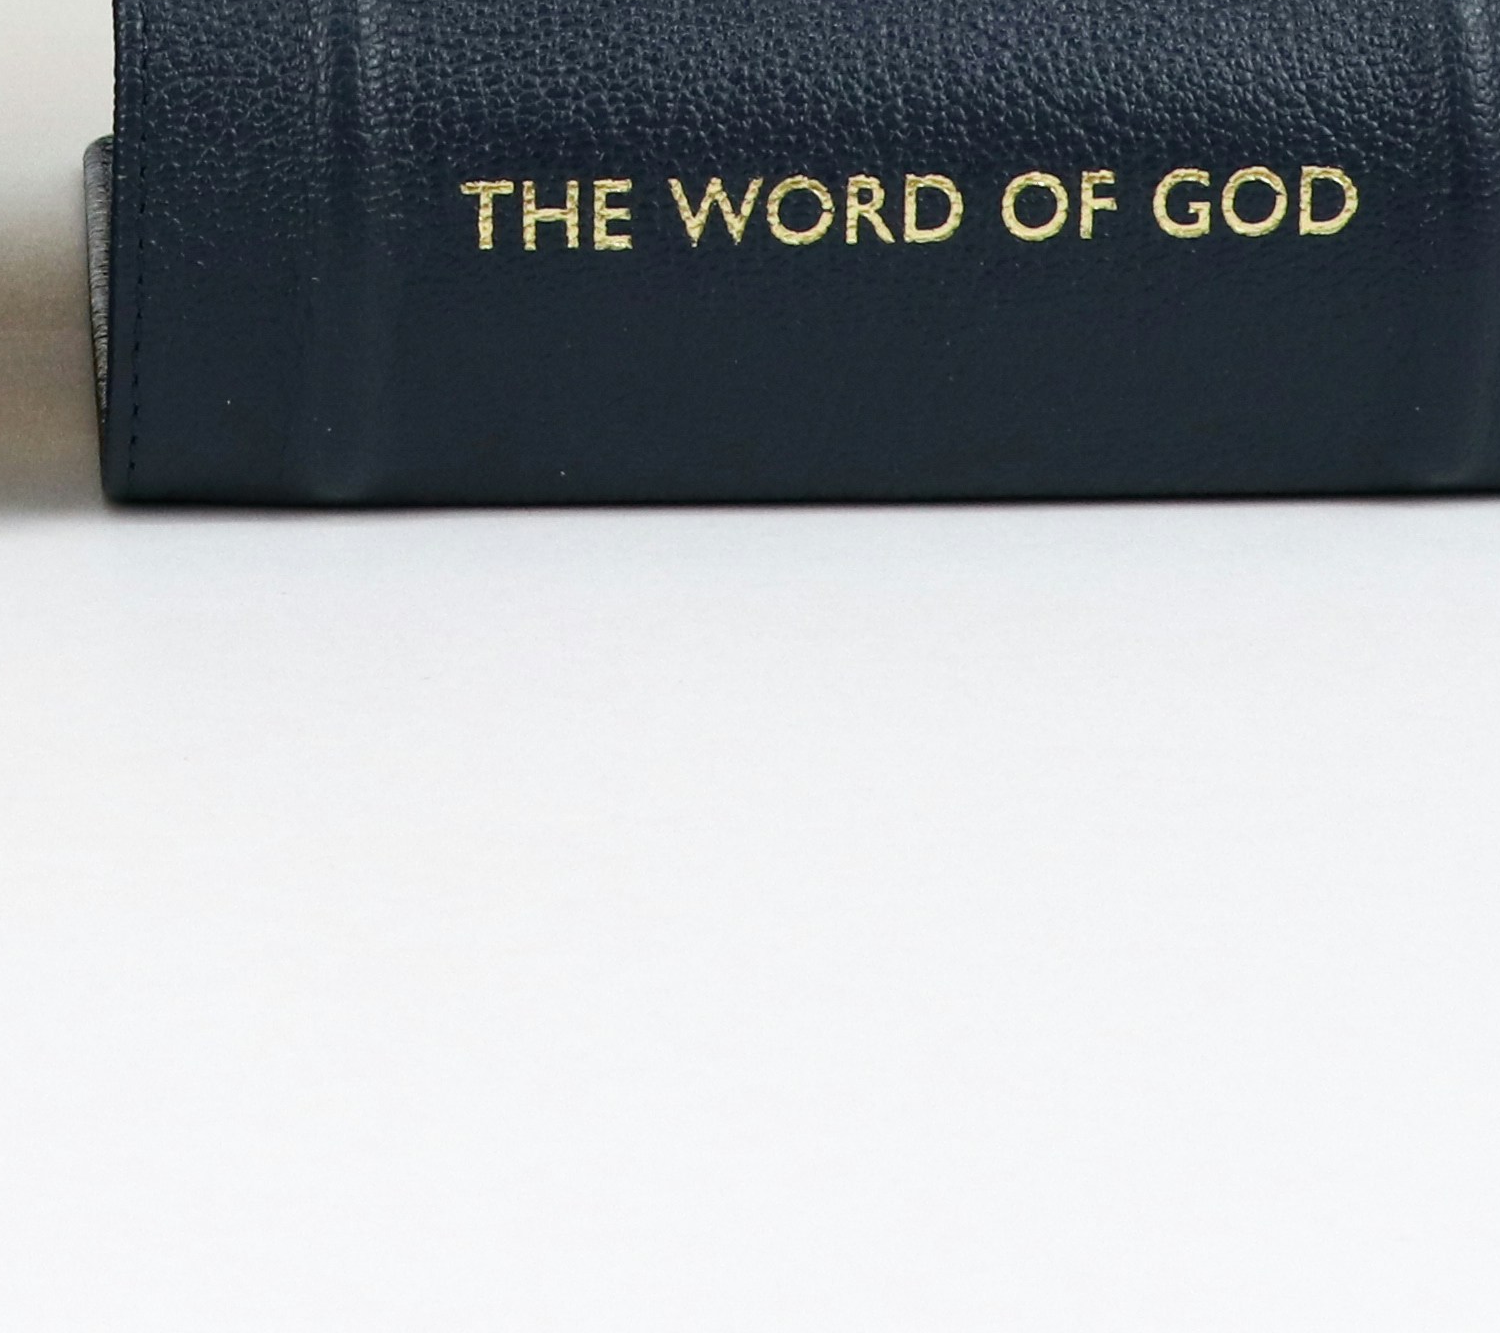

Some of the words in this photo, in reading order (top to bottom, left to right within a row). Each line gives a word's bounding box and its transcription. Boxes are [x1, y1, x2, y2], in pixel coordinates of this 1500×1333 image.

[459, 178, 633, 251] THE
[667, 173, 964, 248] WORD
[1001, 169, 1118, 242] OF
[1152, 165, 1359, 239] GOD
